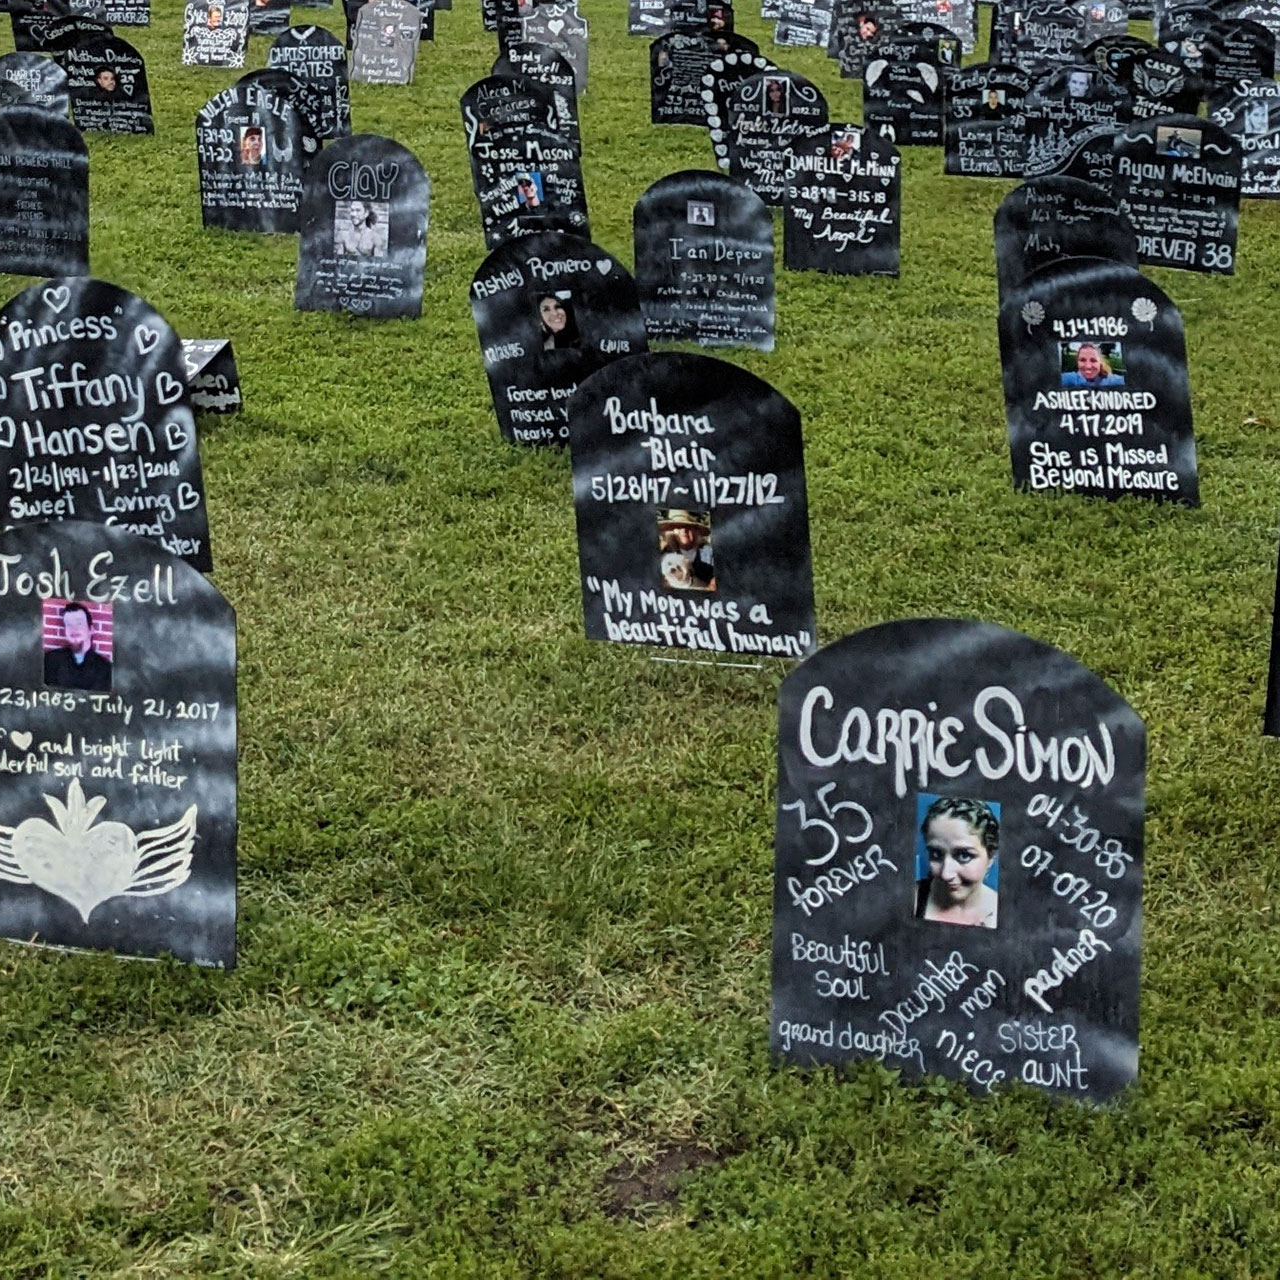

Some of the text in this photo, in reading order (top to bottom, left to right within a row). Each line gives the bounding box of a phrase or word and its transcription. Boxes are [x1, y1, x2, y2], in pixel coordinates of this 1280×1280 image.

[271, 46, 346, 65] CHRISTOPHER
[290, 61, 334, 77] GATES
[478, 141, 521, 161] Jesse
[789, 155, 845, 175] DANIELLE
[1119, 157, 1238, 188] Ryan McElvain
[715, 240, 762, 263] Depew
[1201, 242, 1233, 269] 38
[473, 257, 592, 300] Ashley Romero
[1053, 317, 1128, 338] 4.14.1986
[11, 362, 146, 420] Tiffany
[1033, 390, 1157, 411] ASHLEE KINDRED
[603, 396, 715, 436] Barbara
[1060, 413, 1144, 435] 4.17.2019
[22, 421, 154, 458] Hansen
[513, 426, 553, 440] hearts
[641, 437, 716, 472] Blair
[1030, 442, 1071, 468] She
[1105, 443, 1168, 466] Missed
[10, 454, 88, 492] 2/26/1991
[591, 473, 671, 503] 5/28/47
[1030, 465, 1179, 491] Beyond Measure
[10, 487, 176, 522] Sweet Loving
[86, 550, 177, 605] Ezell
[640, 589, 686, 617] Mom
[690, 598, 740, 620] was
[750, 603, 772, 625] a
[603, 613, 726, 652] beautiful
[39, 735, 182, 764] and bright light
[53, 760, 83, 777] son
[91, 763, 123, 781] and
[129, 766, 186, 790] father
[783, 782, 873, 866] 35
[1026, 793, 1133, 880] 04-30-85
[1021, 845, 1117, 928] 07-09-20
